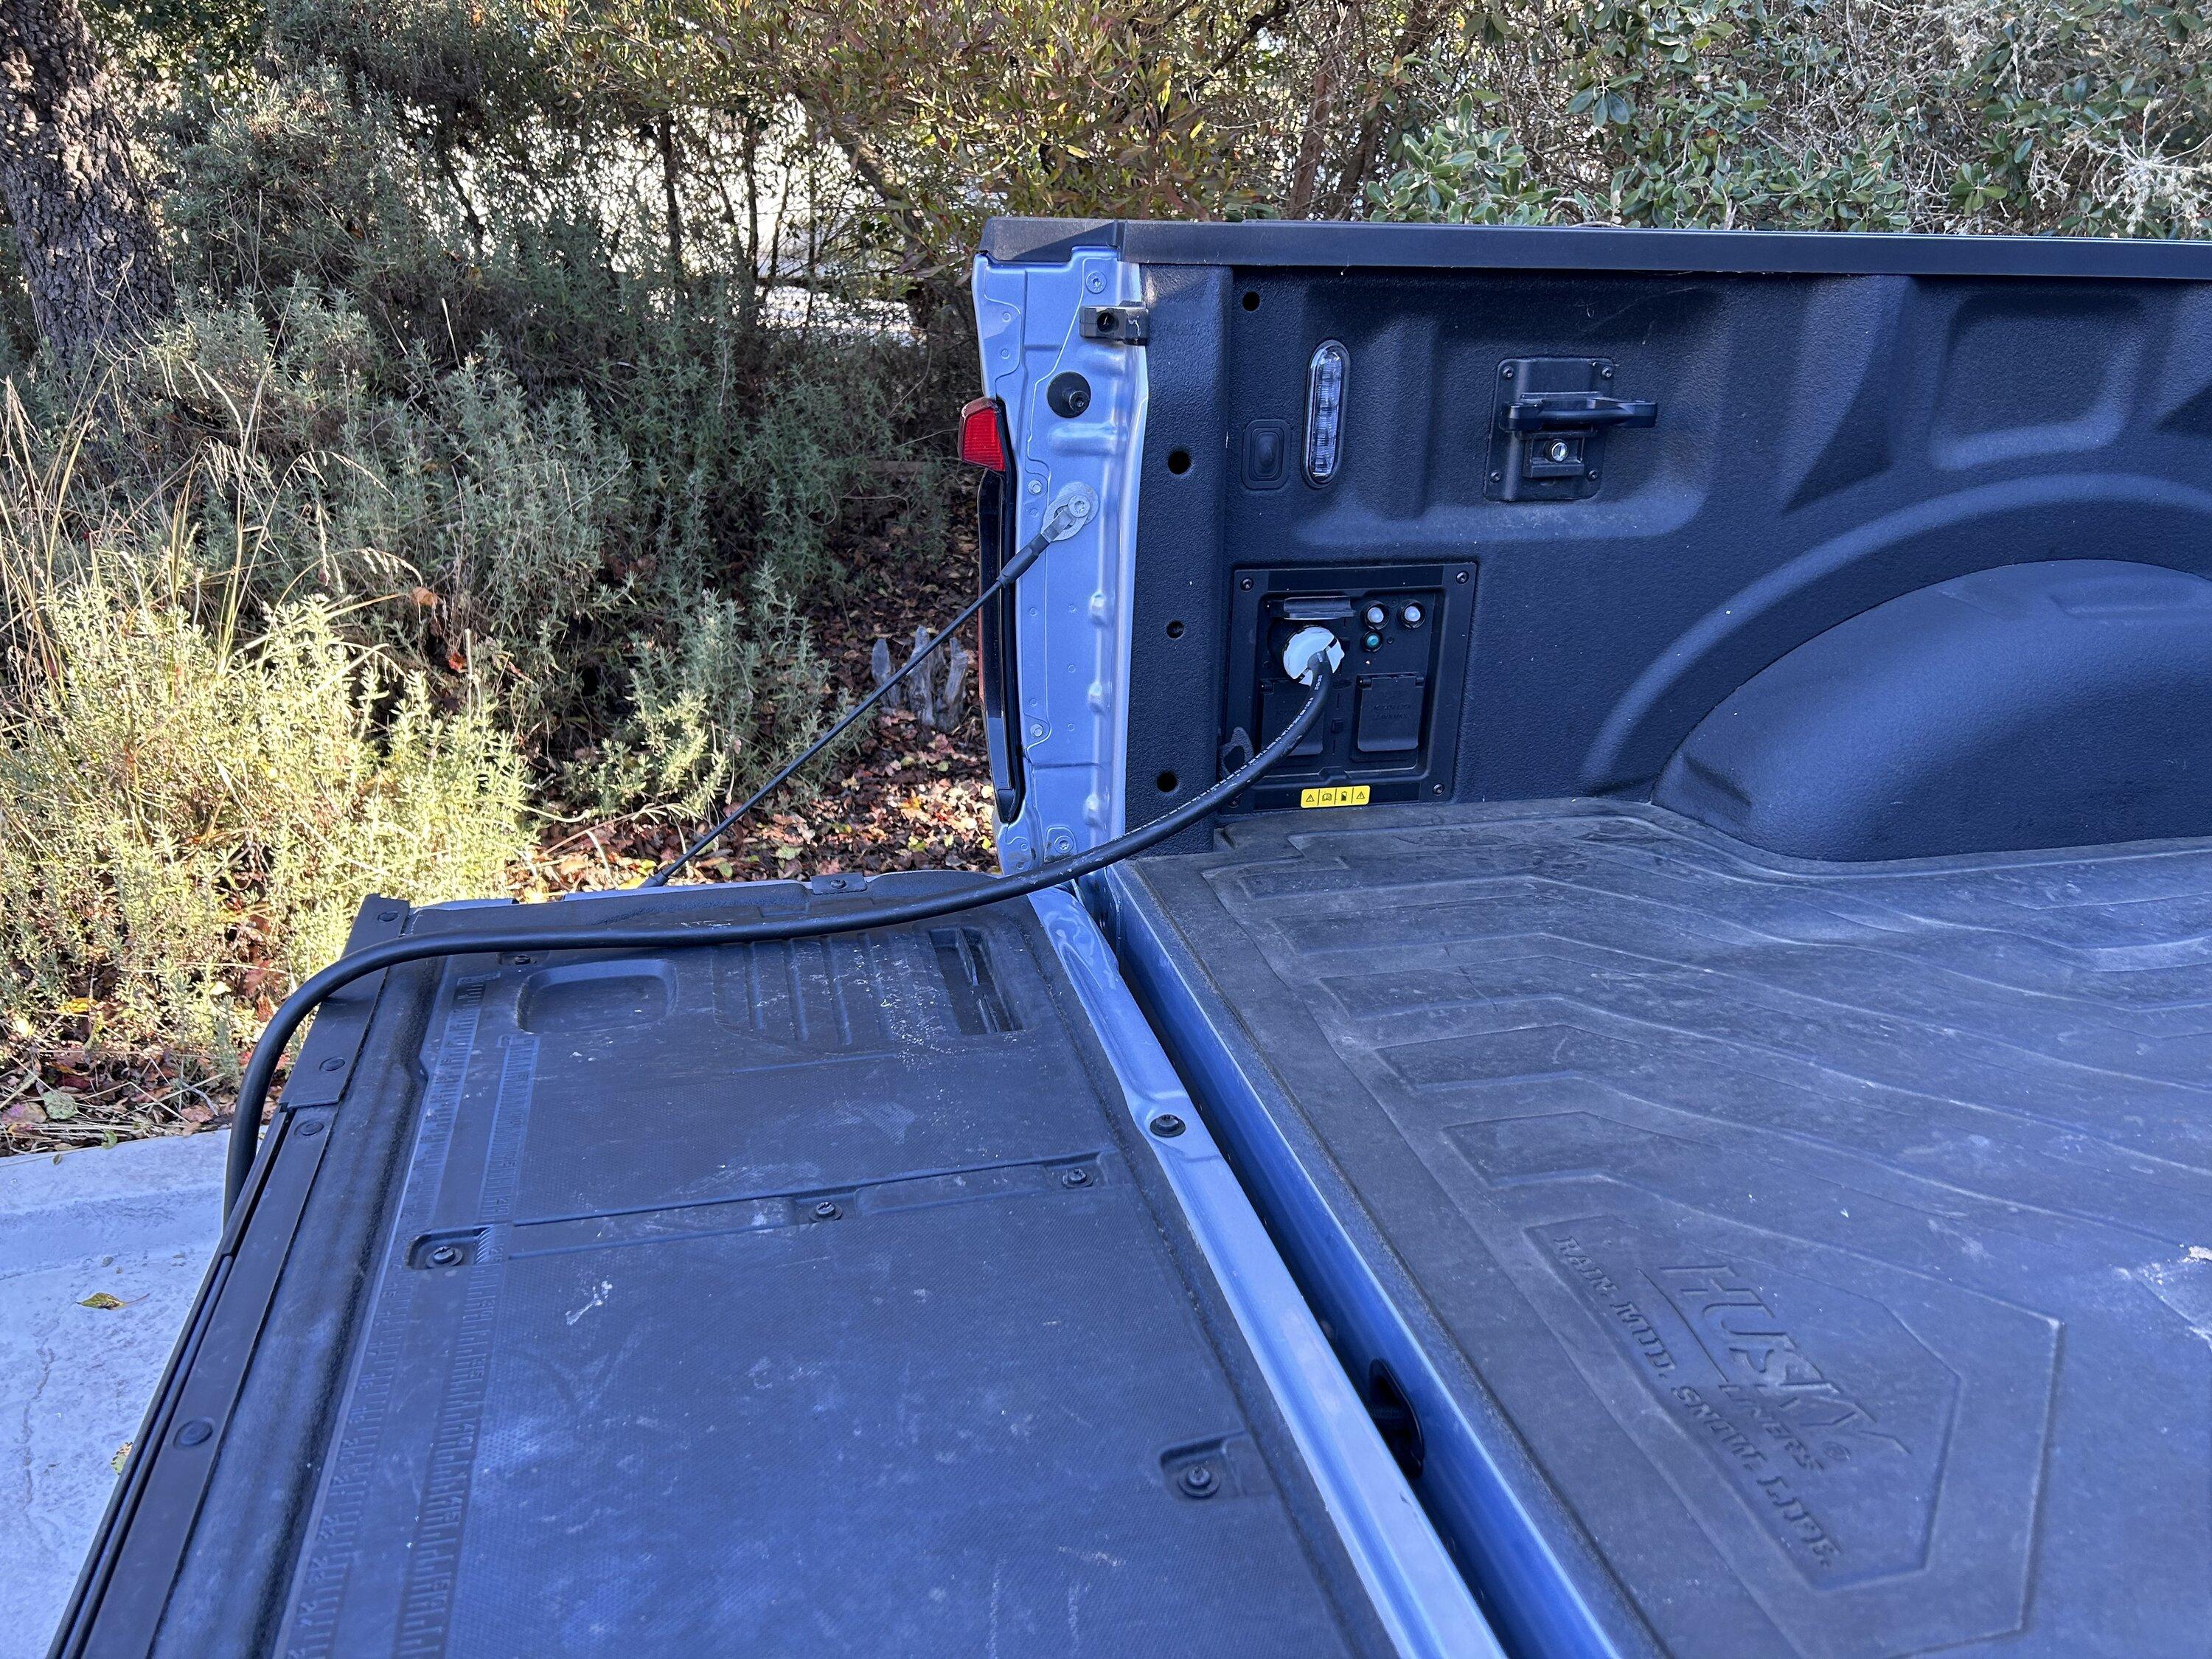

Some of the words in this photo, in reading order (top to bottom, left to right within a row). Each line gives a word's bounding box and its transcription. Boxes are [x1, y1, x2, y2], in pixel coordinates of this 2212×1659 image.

[1554, 1235, 1621, 1298] RAIN.
[479, 1299, 495, 1317] 30
[1659, 1265, 1913, 1455] HUSKY
[456, 1424, 475, 1446] 40
[444, 1497, 463, 1523] 45
